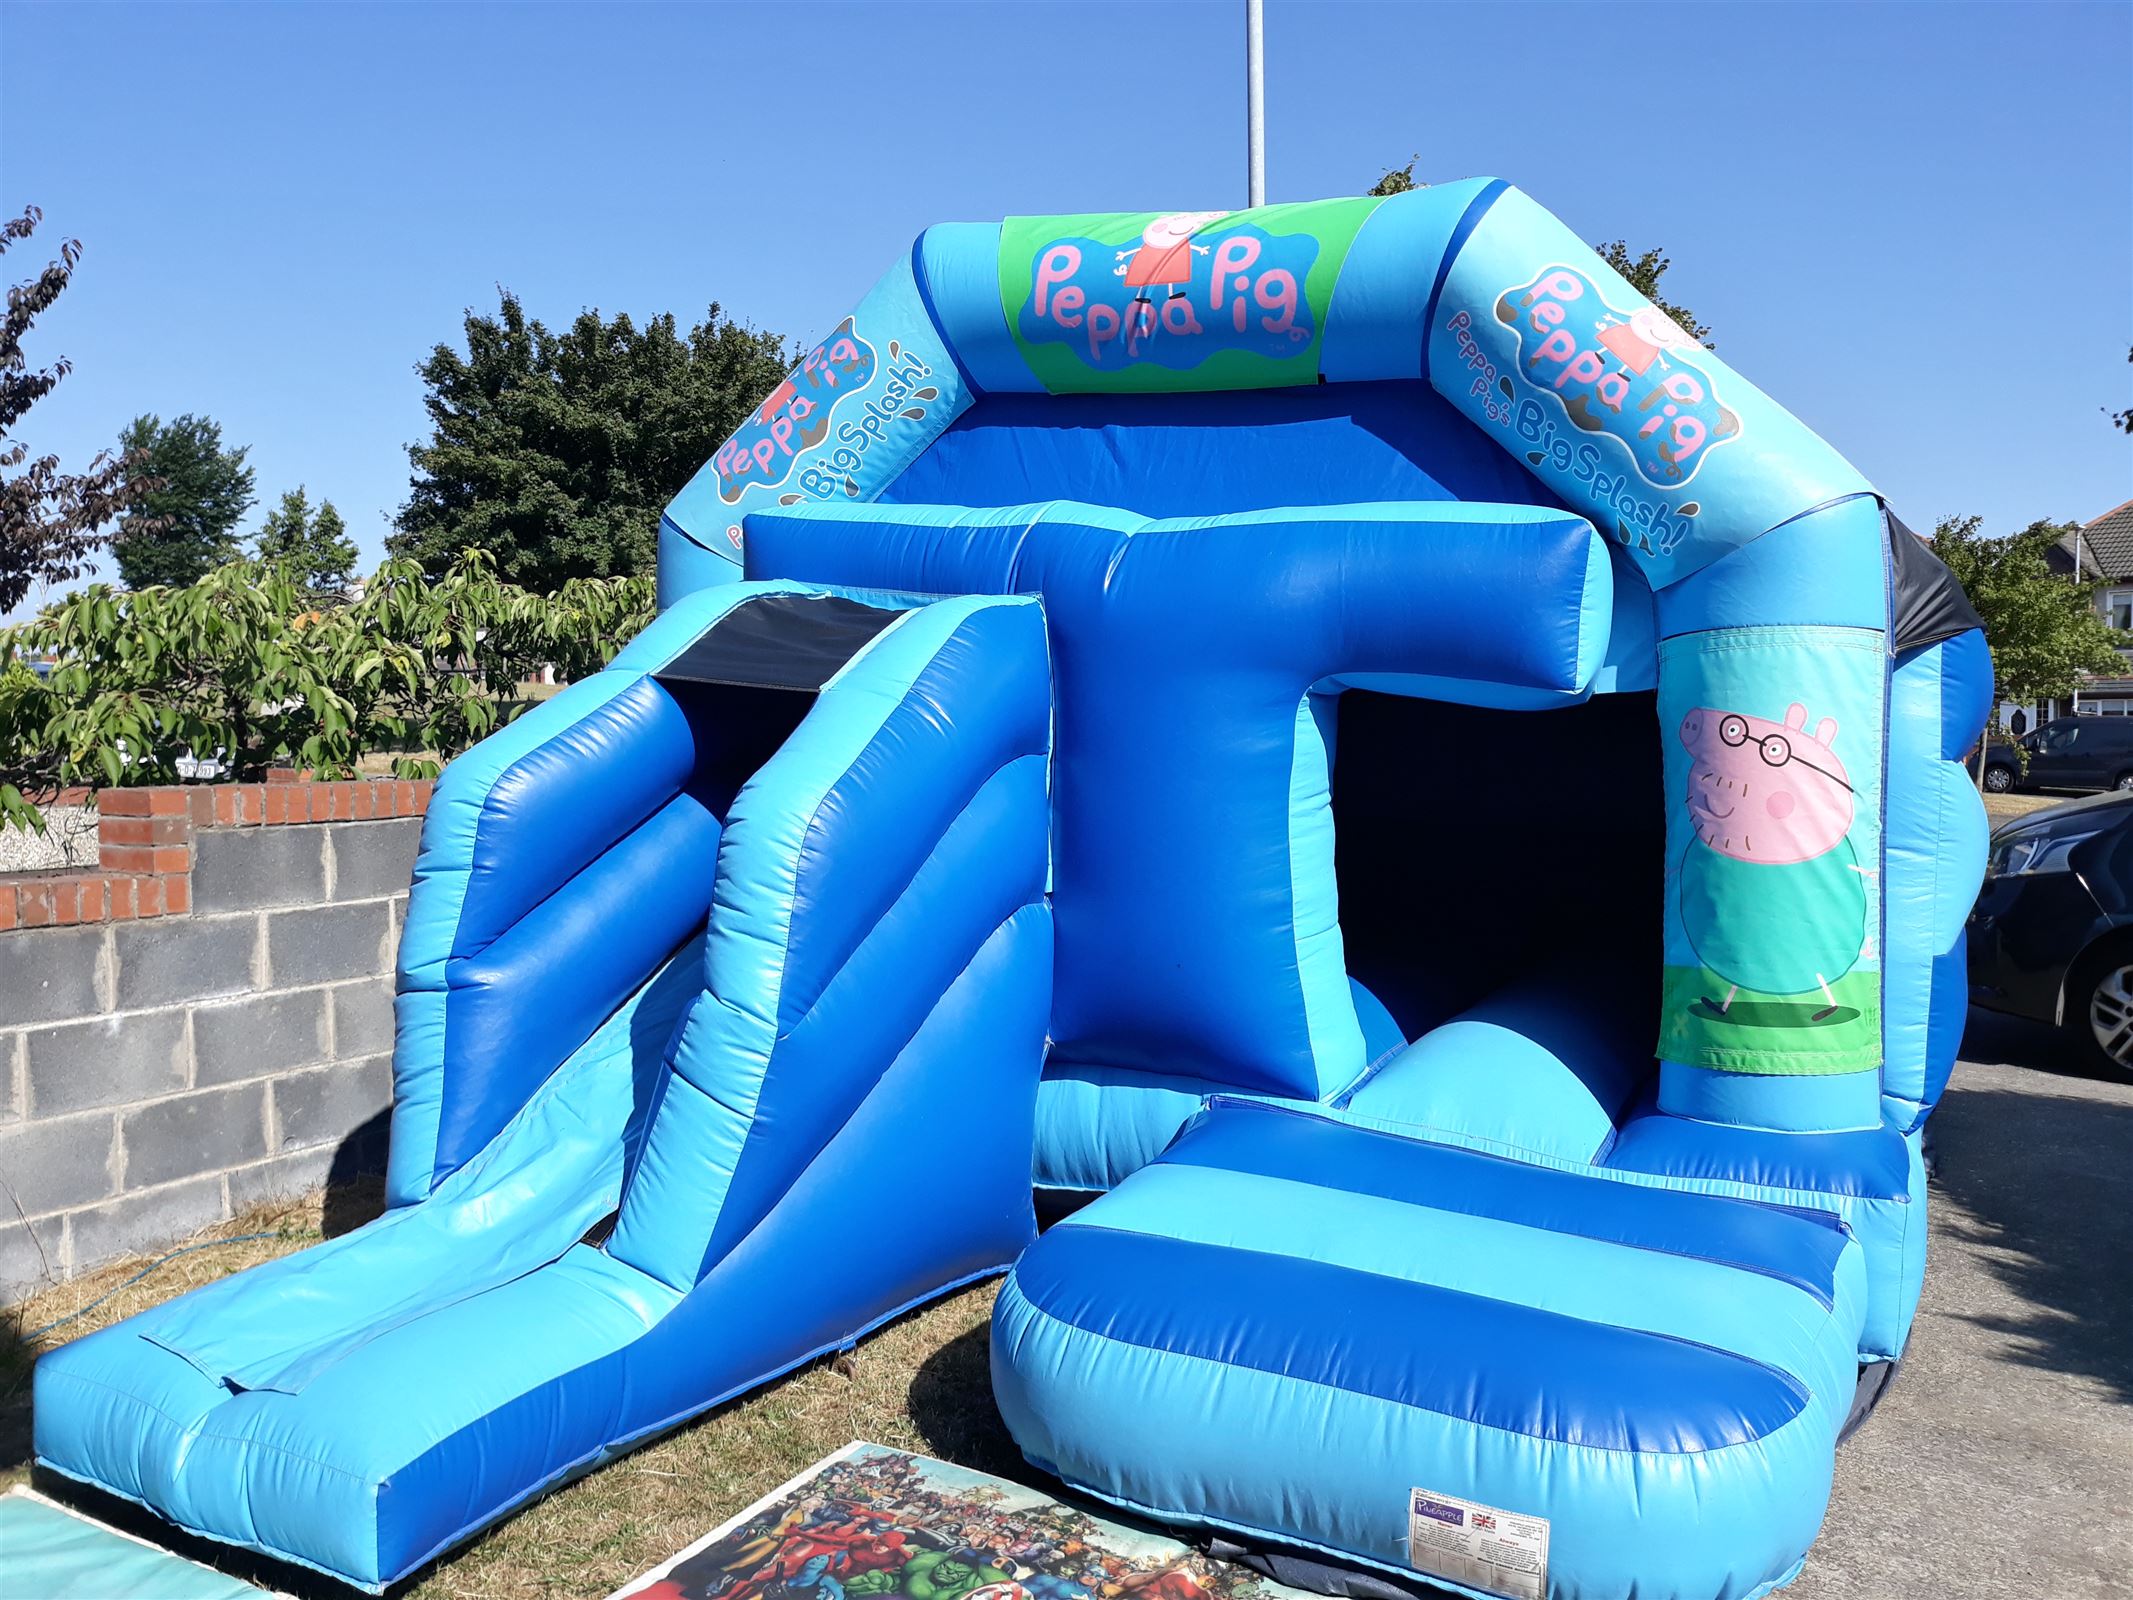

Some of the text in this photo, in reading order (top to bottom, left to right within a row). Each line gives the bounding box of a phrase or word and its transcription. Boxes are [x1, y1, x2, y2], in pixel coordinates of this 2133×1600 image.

[1034, 236, 1309, 361] Peppa Pig
[1447, 311, 1496, 384] Peppa
[717, 338, 870, 482] Peppa Pig
[799, 351, 932, 500] Big Splash!
[1470, 377, 1510, 427] Pig's
[1520, 271, 1706, 480] Peppa Pig
[1515, 399, 1689, 556] Big Splash!
[1417, 1500, 1462, 1522] PINEAPPLE
